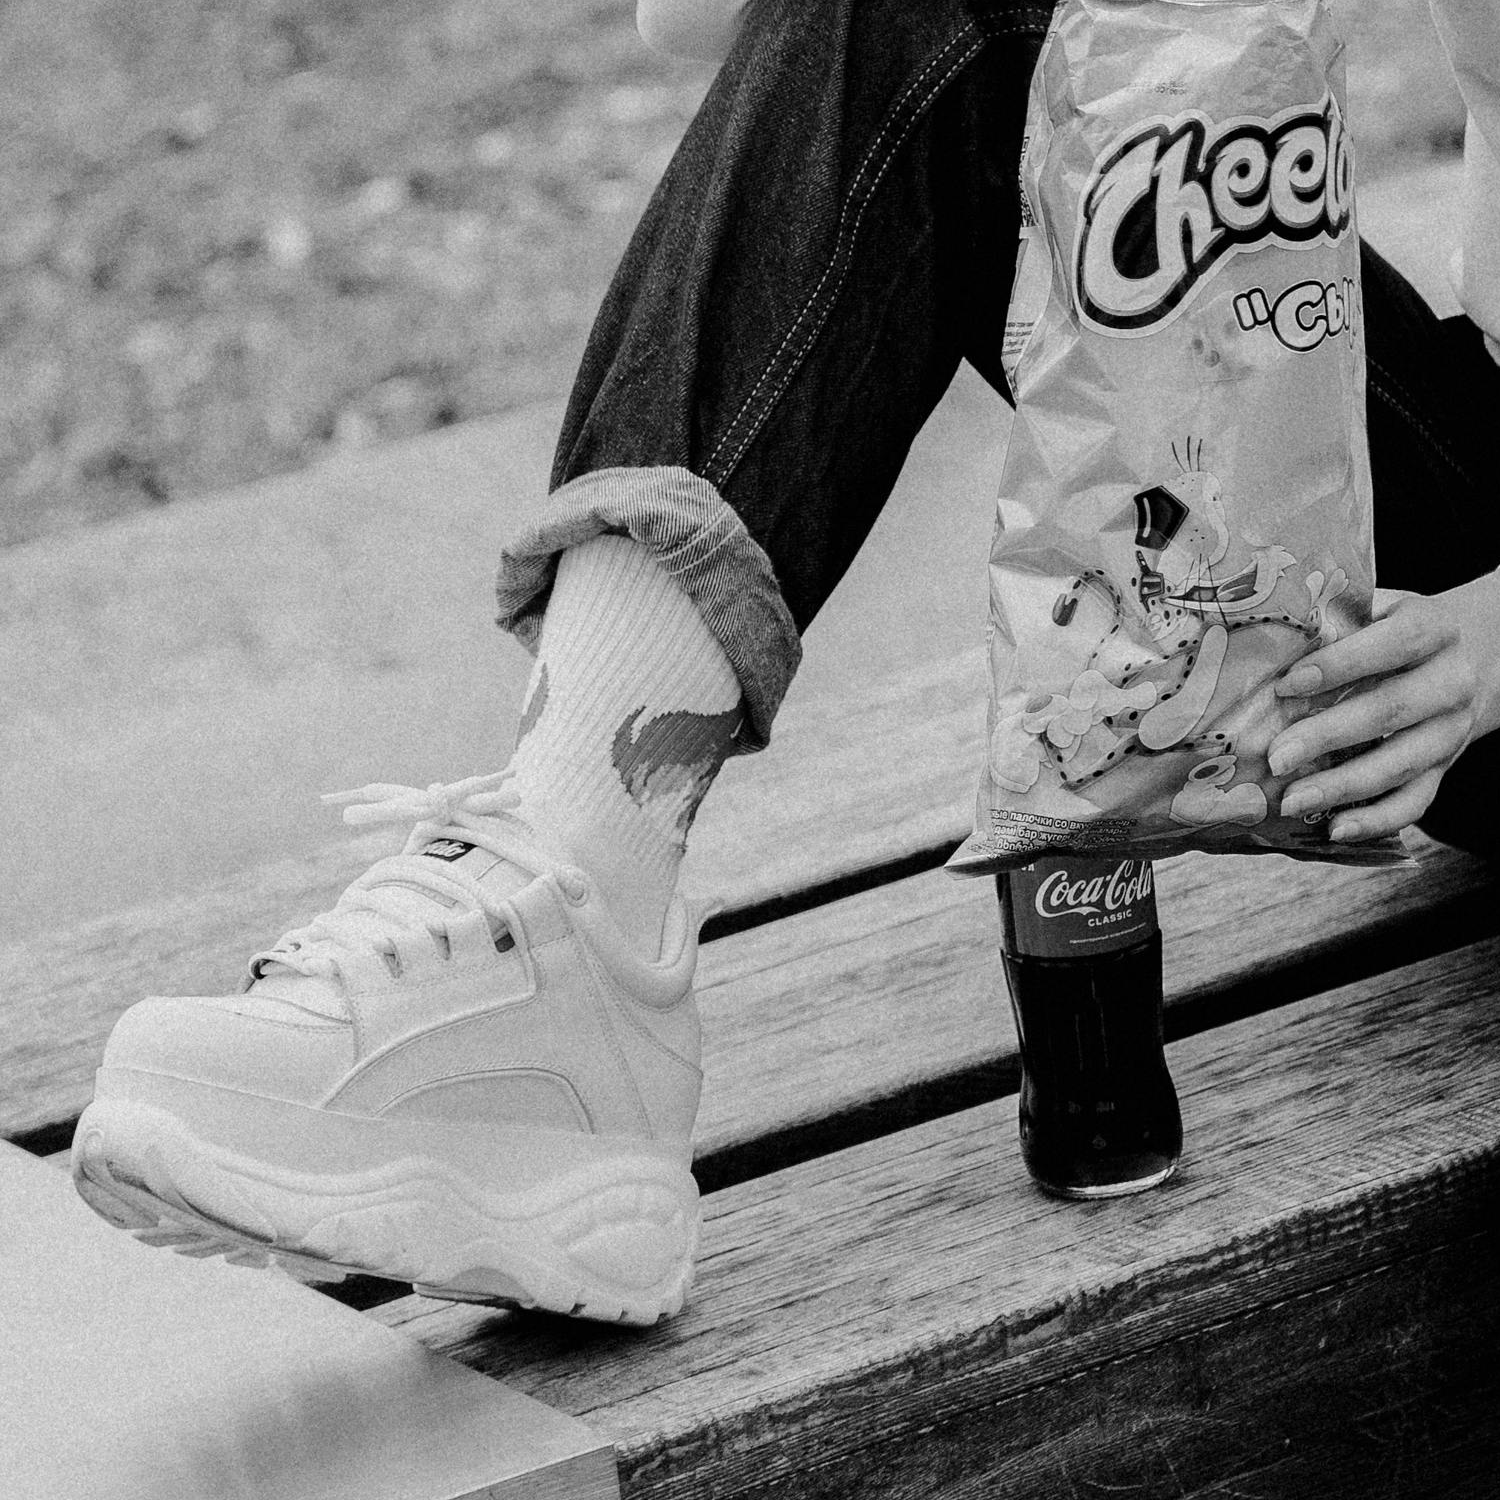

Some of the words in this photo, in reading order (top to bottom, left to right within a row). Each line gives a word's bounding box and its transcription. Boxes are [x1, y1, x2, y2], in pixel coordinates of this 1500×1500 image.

[1010, 811, 1053, 827] палочки
[1054, 819, 1068, 828] со
[1018, 826, 1038, 840] бар
[1087, 908, 1133, 927] CLASSIC
